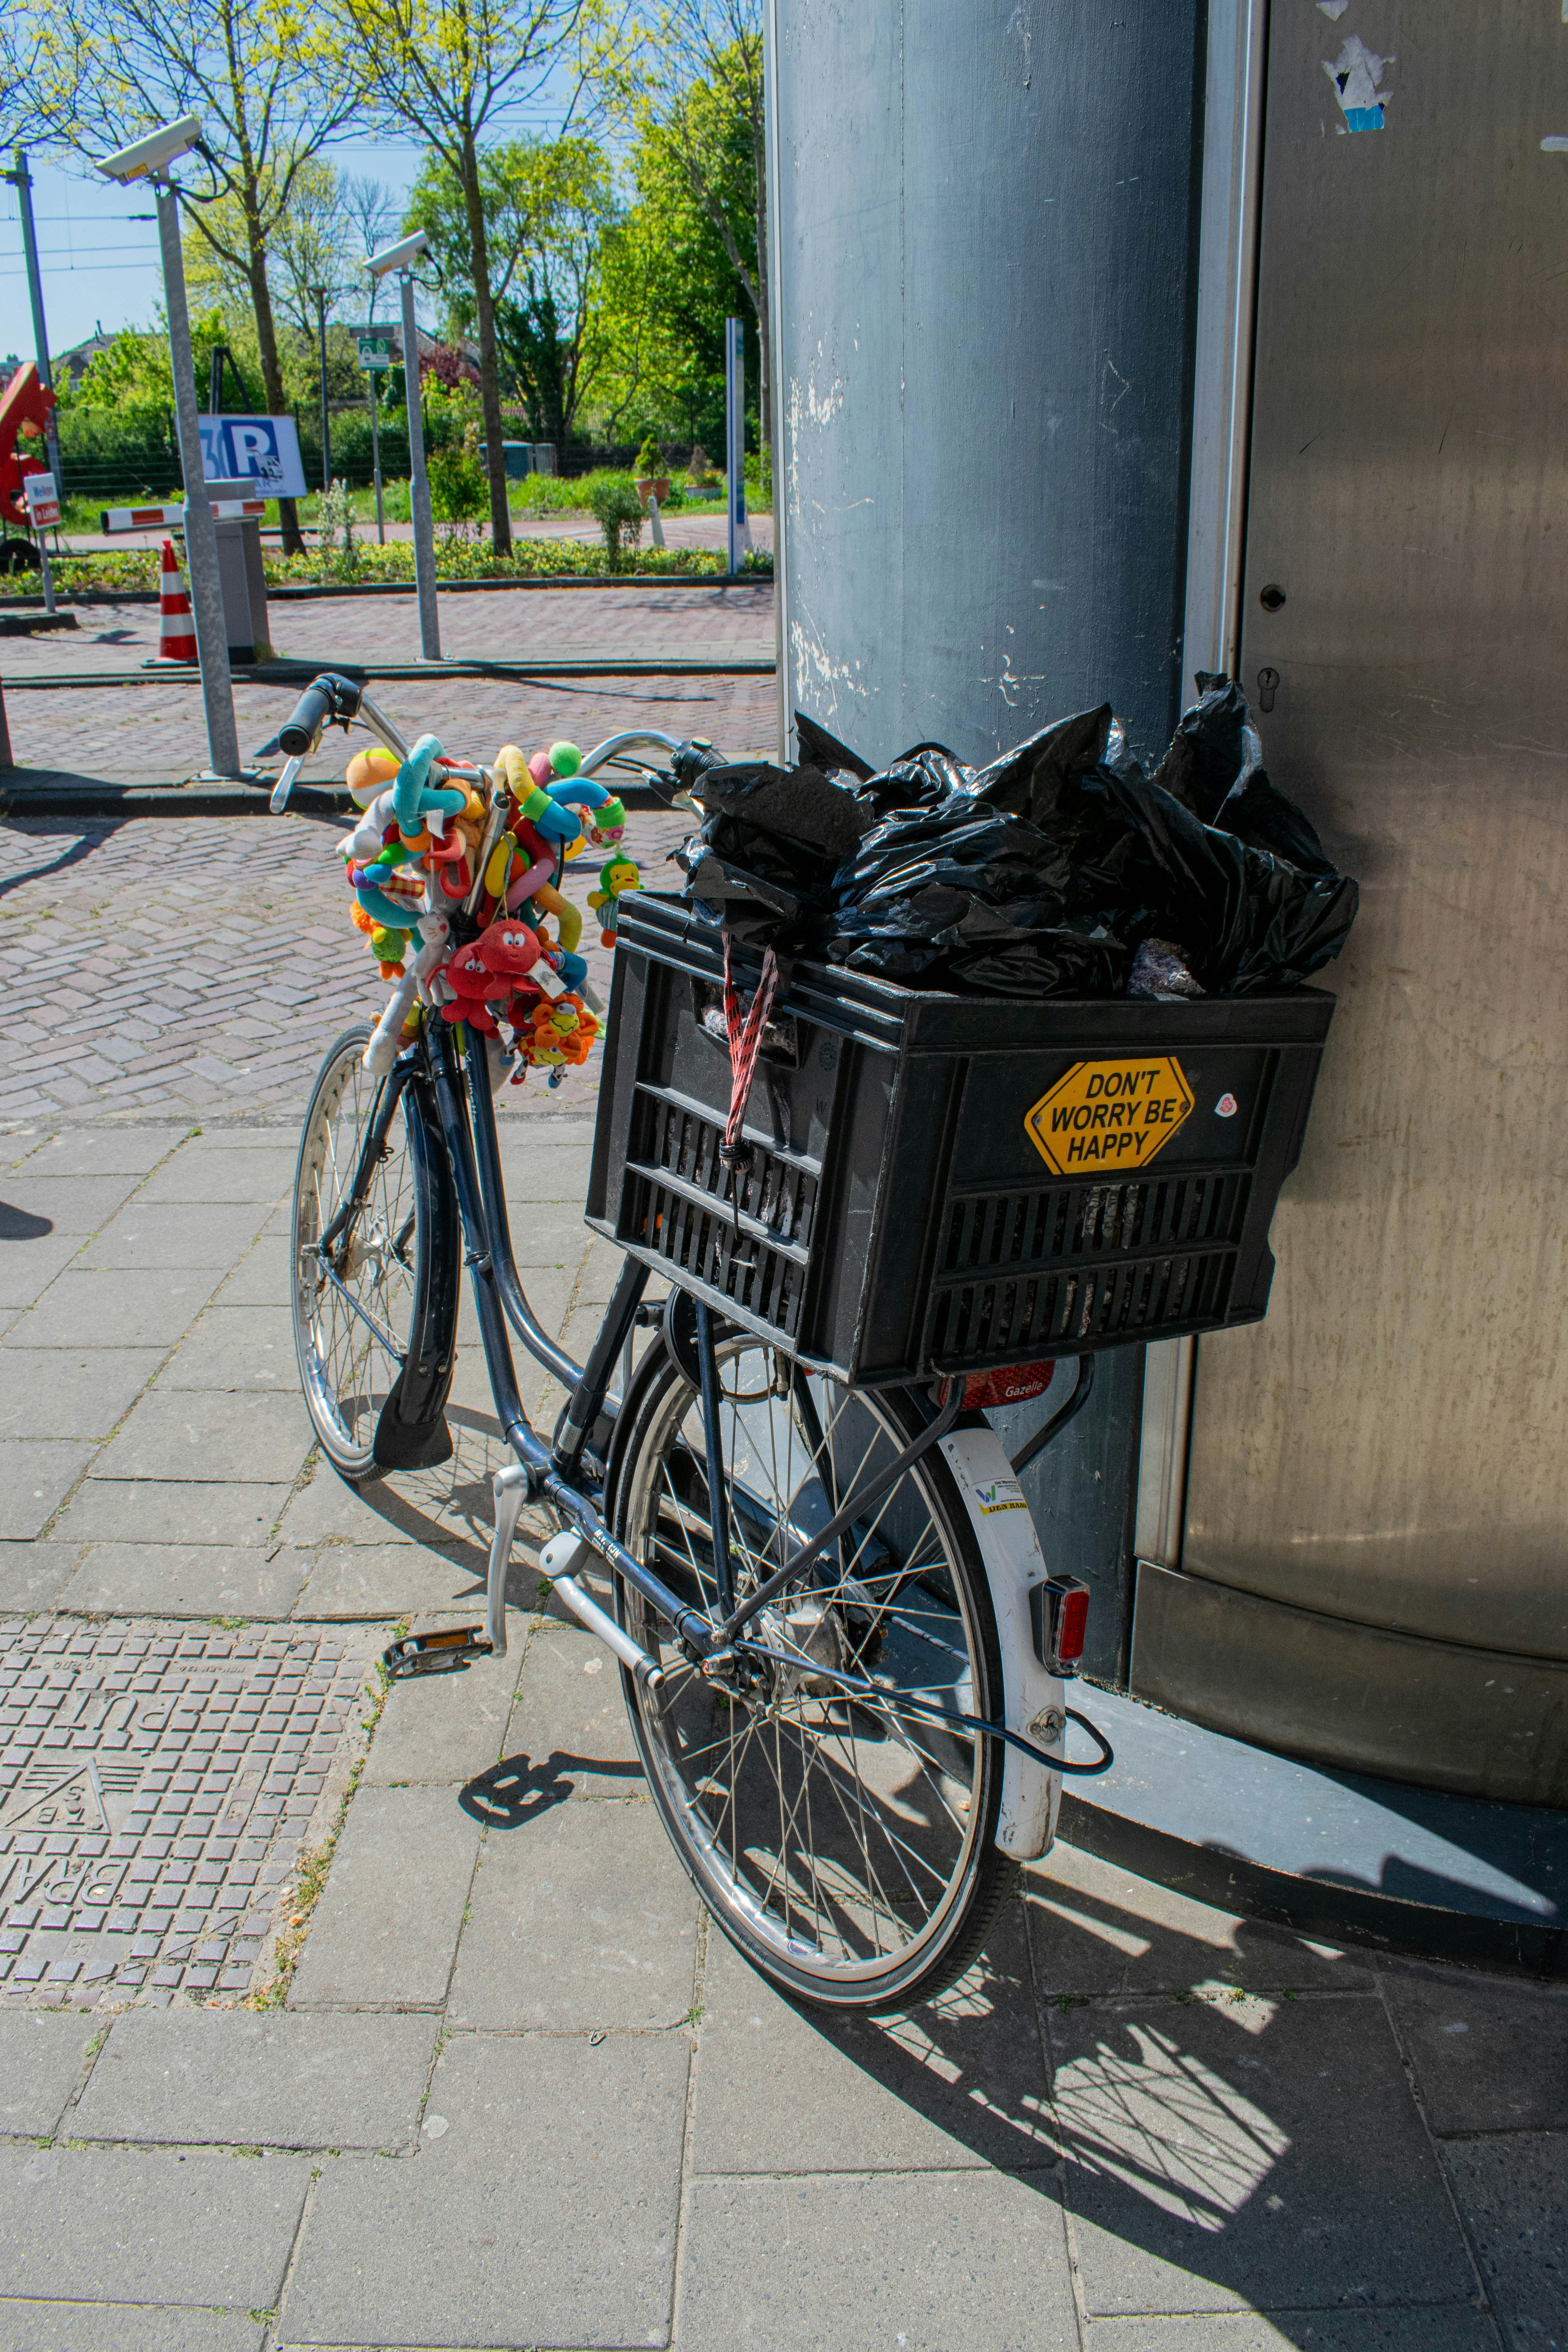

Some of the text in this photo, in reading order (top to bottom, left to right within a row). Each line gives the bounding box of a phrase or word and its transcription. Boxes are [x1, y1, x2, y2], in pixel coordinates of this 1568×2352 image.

[230, 425, 271, 474] P
[1085, 1070, 1161, 1099] DON'T
[1051, 1098, 1178, 1132] WORRY BE
[1067, 1131, 1150, 1162] HAPPY
[1005, 1381, 1043, 1397] Gazelle
[989, 1504, 1007, 1513] DEN
[54, 1692, 180, 1732] PUT
